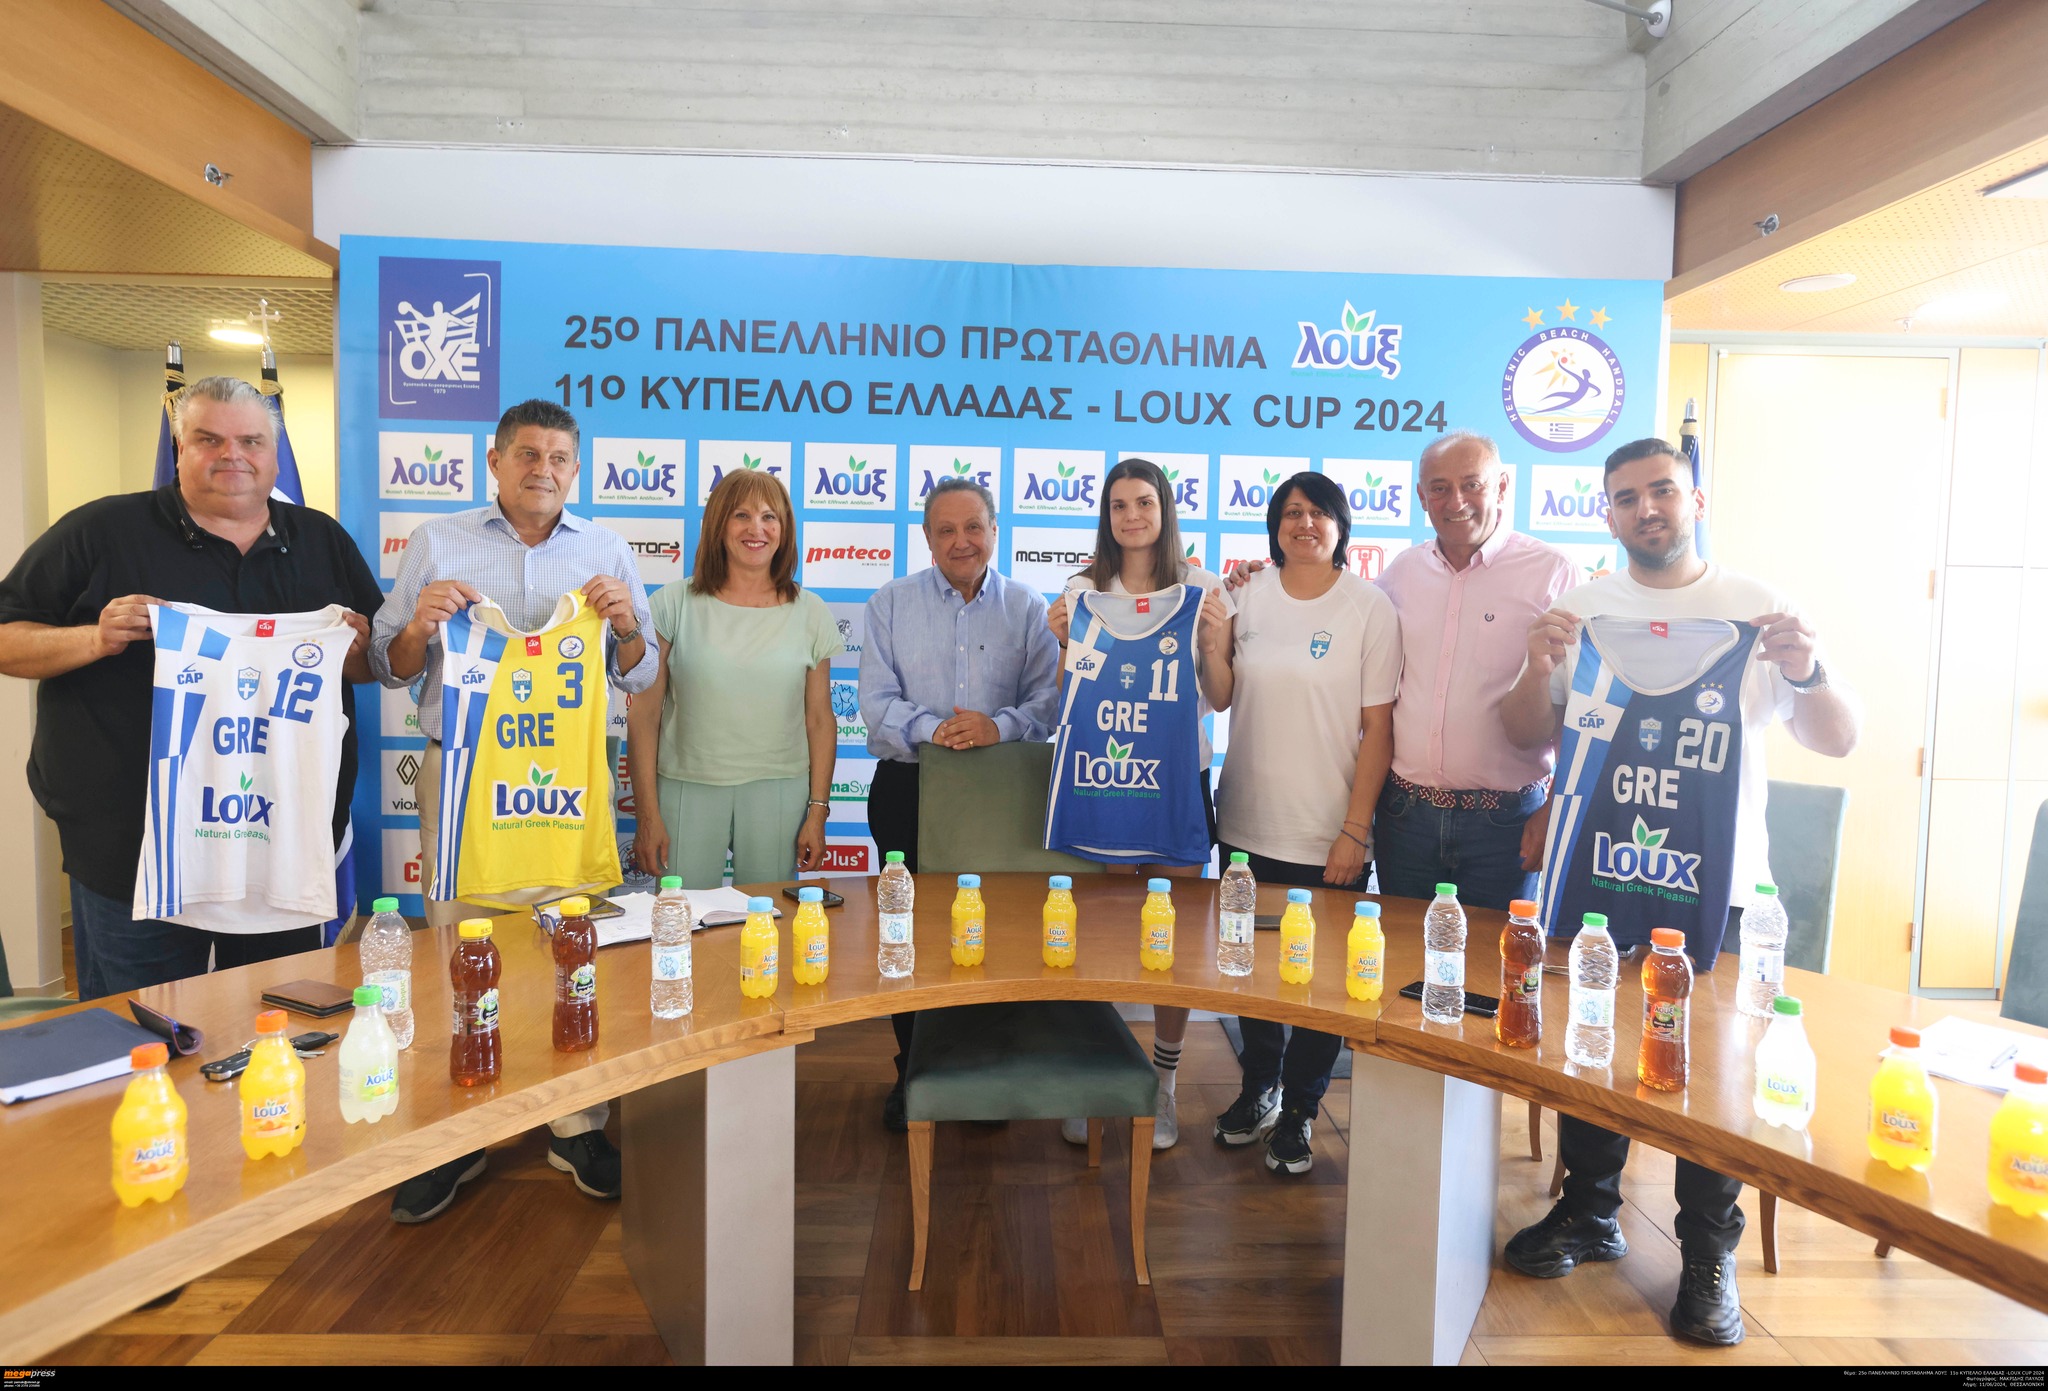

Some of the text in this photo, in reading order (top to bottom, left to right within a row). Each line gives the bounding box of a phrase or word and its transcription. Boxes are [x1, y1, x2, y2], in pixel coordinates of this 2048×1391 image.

[655, 317, 946, 358] ΠΑΝΕΛΛΗΝΙΟ
[961, 325, 1267, 370] ΠΡΩΤΑΘΛΗΜΑ
[1539, 328, 1589, 342] BEACH
[1503, 348, 1526, 422] HELLENIC
[1601, 347, 1624, 425] HANDBALL
[642, 376, 852, 414] ΚΥΠΕΛΛΟ
[867, 381, 1073, 421] ΕΛΛΑΔΑΣ
[1114, 389, 1232, 427] LOUX
[1253, 394, 1342, 430] CUP
[1353, 398, 1448, 433] 2024
[390, 456, 464, 493] λουξ
[603, 463, 676, 497] λουξ
[814, 467, 887, 502] λουξ
[1023, 473, 1096, 508] λουξ
[805, 545, 892, 564] mateco
[177, 671, 204, 685] CAP
[461, 673, 486, 685] CAP
[1075, 661, 1096, 672] CAP
[1148, 658, 1180, 702] 11
[268, 667, 324, 724] 12
[557, 662, 584, 709] 3
[496, 712, 555, 749] GRE
[1096, 699, 1149, 733] GRE
[1578, 716, 1605, 729] CAP
[212, 716, 270, 756] GRE
[1674, 717, 1731, 773] 20
[1073, 788, 1161, 799] Natural Greek Pleasure
[1612, 764, 1680, 809] GRE
[195, 828, 231, 840] Natural
[492, 820, 523, 831] Natural
[525, 819, 551, 828] Greek
[1591, 876, 1625, 893] Natural
[1626, 882, 1654, 896] Greek
